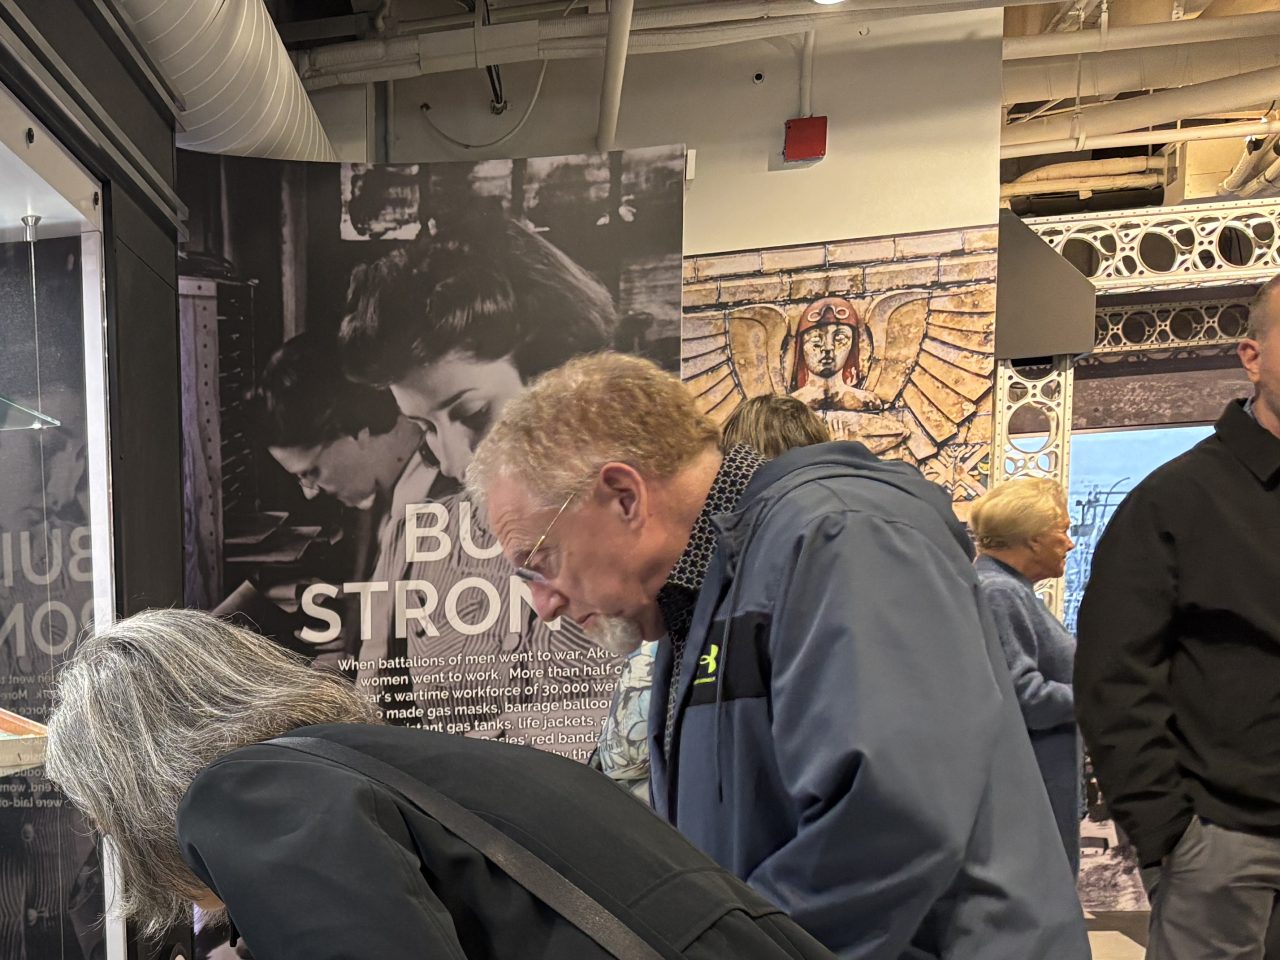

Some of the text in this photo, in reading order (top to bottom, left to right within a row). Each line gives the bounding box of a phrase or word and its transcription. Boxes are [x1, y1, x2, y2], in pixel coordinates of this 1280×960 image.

[300, 575, 561, 642] STRON
[338, 658, 376, 671] When
[378, 655, 445, 669] battalions
[448, 654, 463, 666] of
[465, 655, 496, 665] men
[498, 651, 534, 664] went
[536, 650, 553, 662] to
[554, 651, 584, 663] war,
[360, 664, 611, 686] women went to work. More than half
[370, 691, 391, 703] ar's
[394, 688, 449, 702] wartime
[452, 684, 522, 699] workforce
[524, 684, 539, 696] of
[542, 684, 589, 698] 30,000
[387, 698, 611, 720] made gas masks, barrage balloo
[446, 722, 471, 734] gas
[473, 718, 515, 732] tanks,
[518, 717, 541, 729] life
[541, 715, 598, 731] jackets,
[530, 733, 554, 744] red
[558, 732, 600, 744] banda
[572, 749, 592, 760] the
